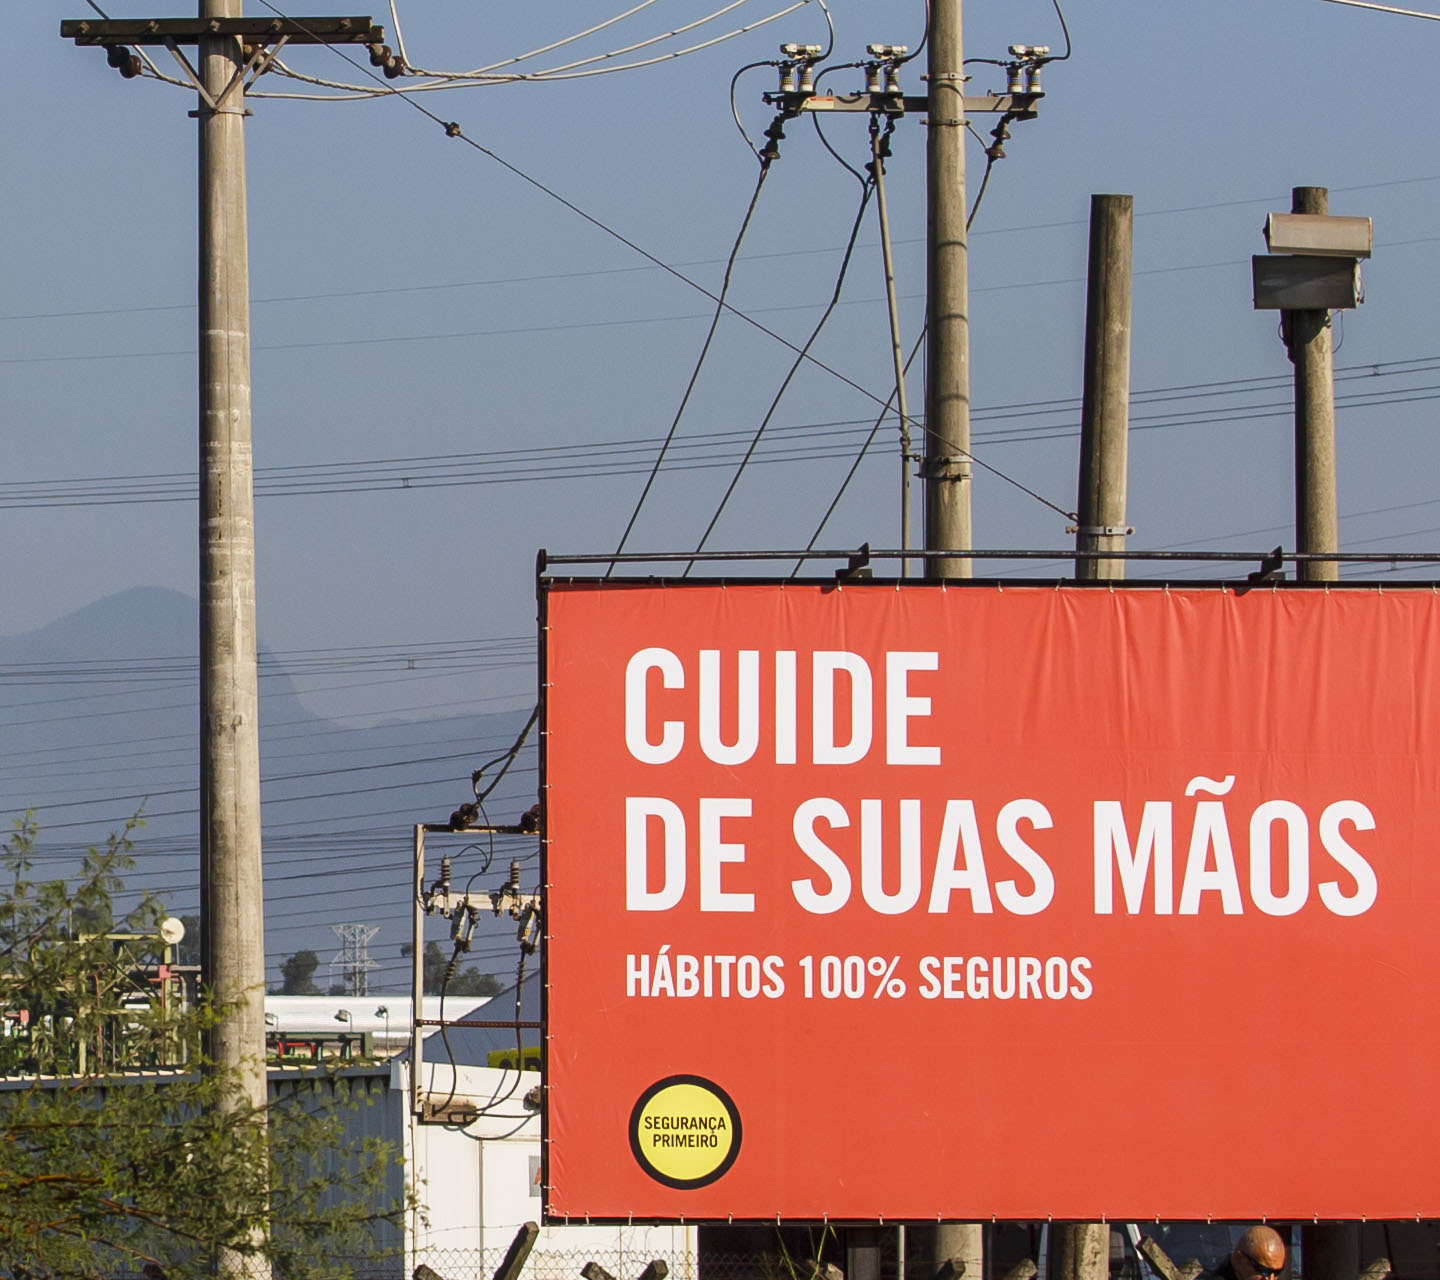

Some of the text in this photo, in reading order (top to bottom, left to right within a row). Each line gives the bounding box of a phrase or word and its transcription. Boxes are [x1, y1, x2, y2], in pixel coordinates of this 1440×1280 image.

[624, 647, 942, 766] CUIDE
[625, 775, 1379, 917] DE SUAS MÃOS
[626, 944, 1094, 1000] HÁBITOS 100% SEGUROS
[644, 1116, 726, 1134] SEGURANÇA
[652, 1133, 718, 1148] PRIMEIRO
